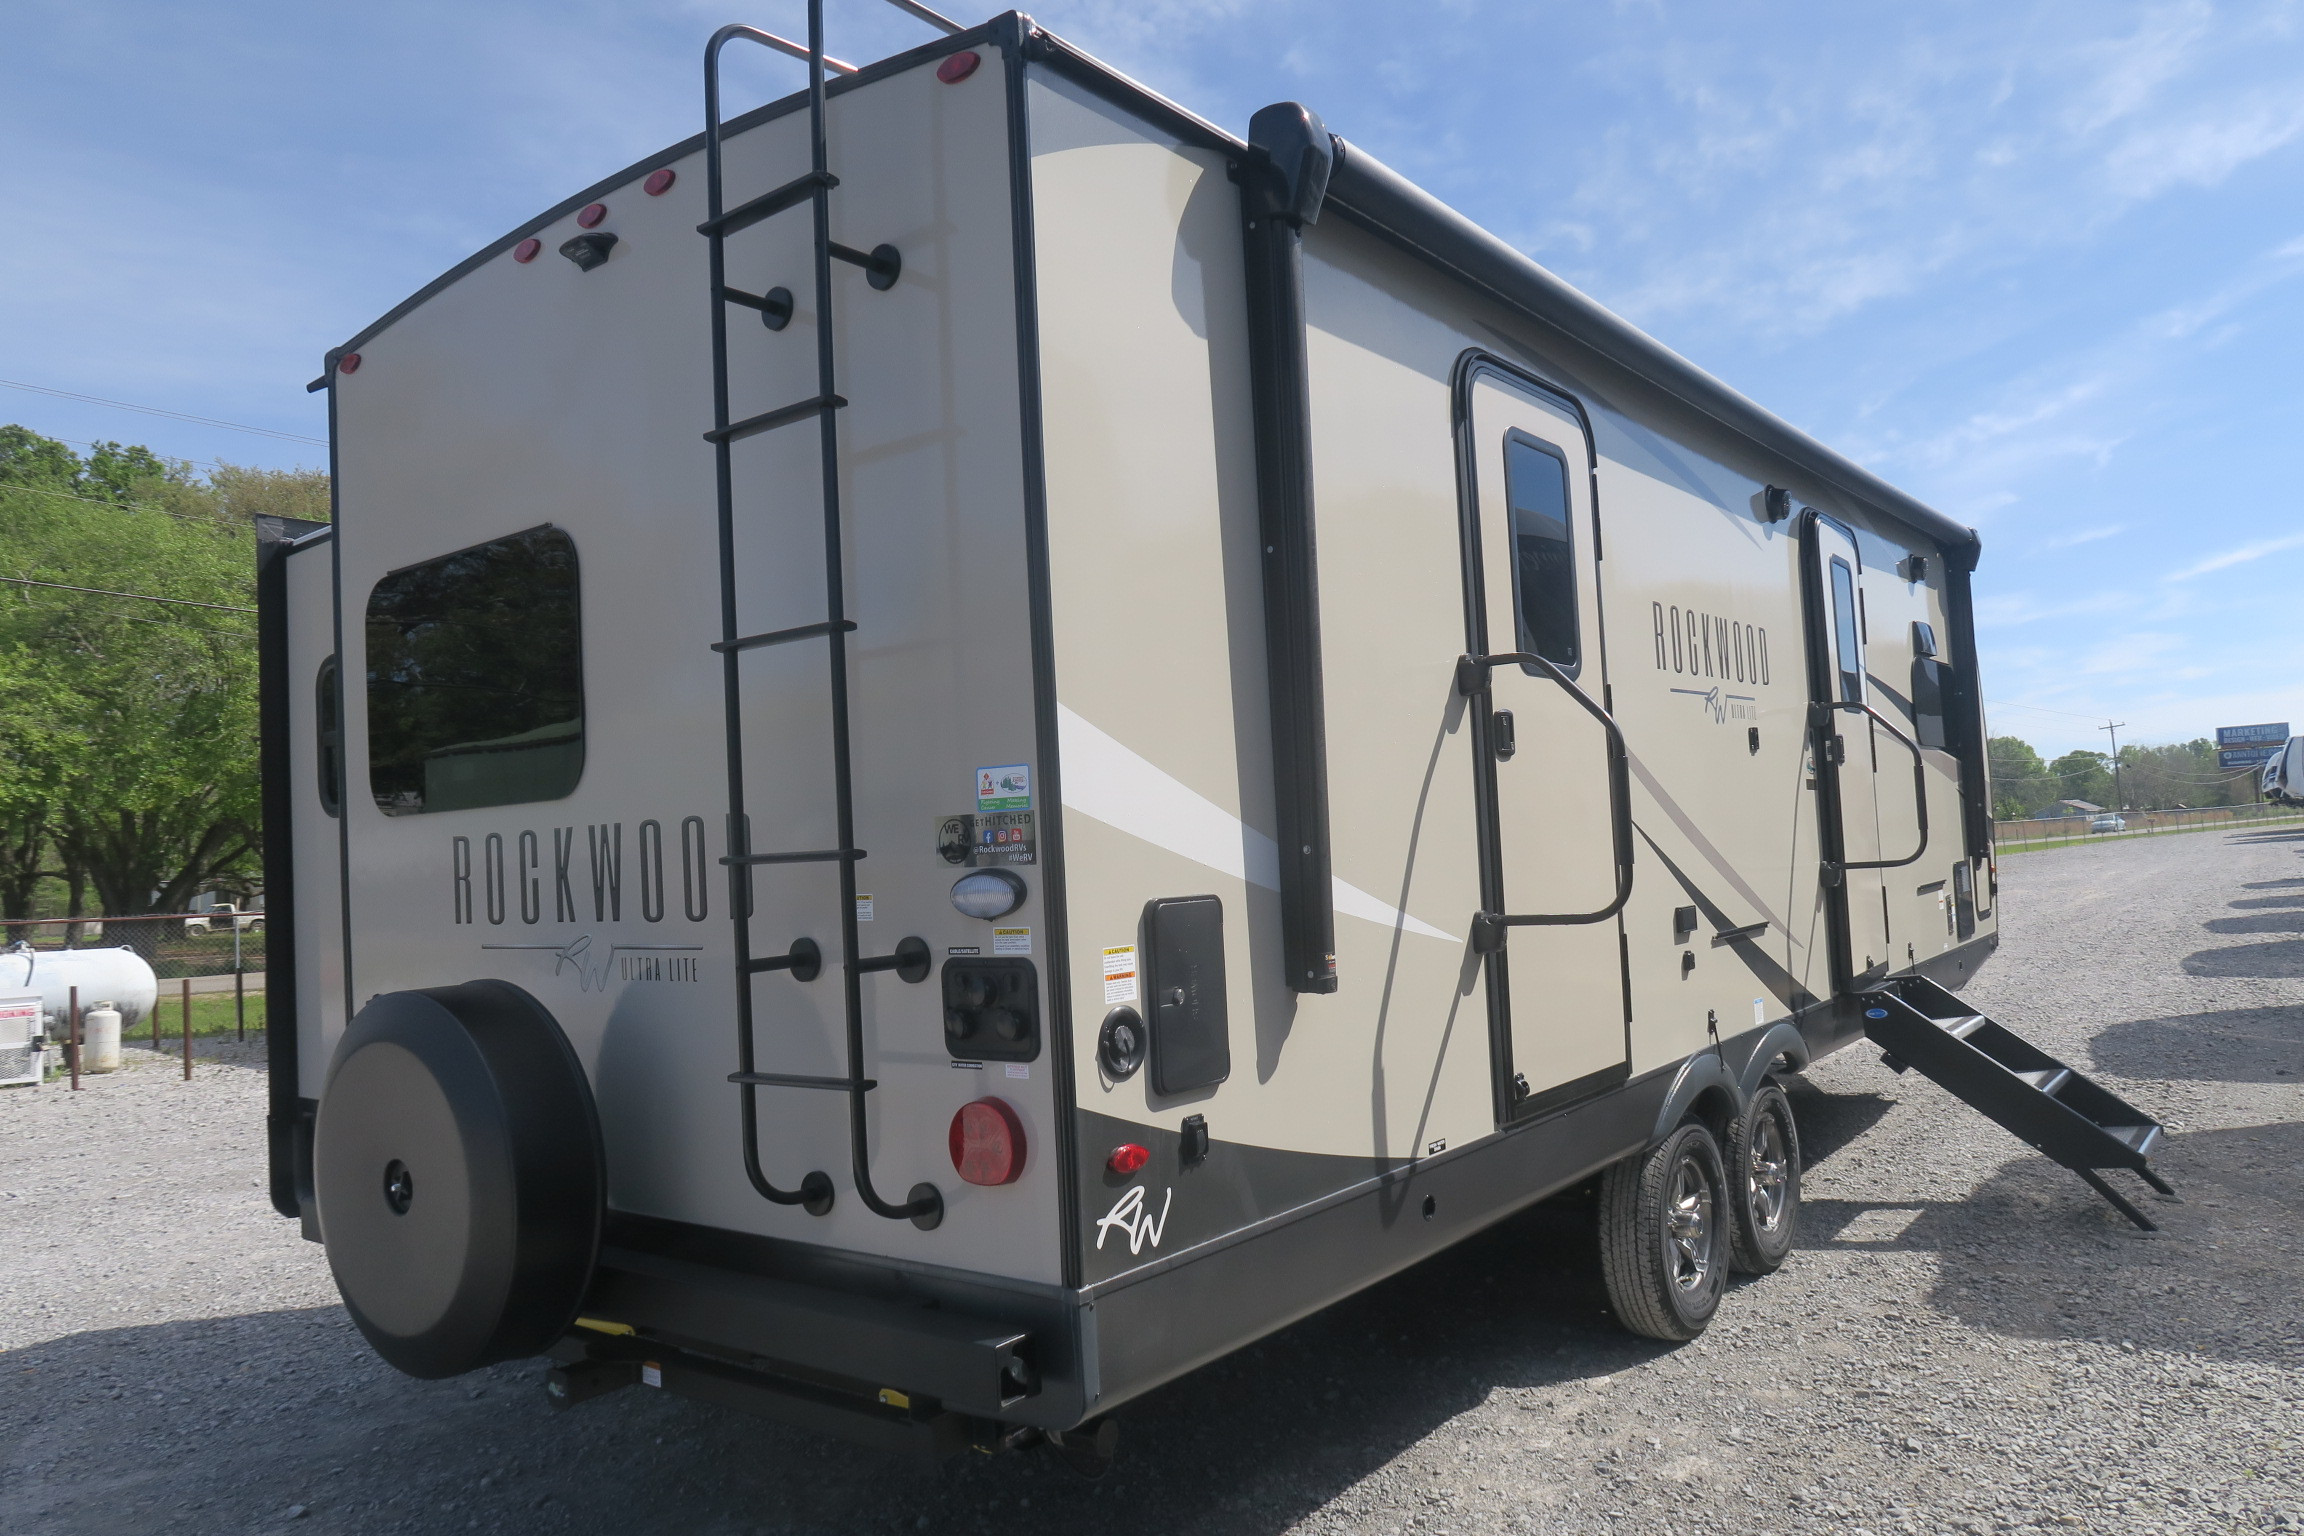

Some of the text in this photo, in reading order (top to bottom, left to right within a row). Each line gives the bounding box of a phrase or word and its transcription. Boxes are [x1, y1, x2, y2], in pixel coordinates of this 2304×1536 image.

[1652, 600, 1769, 685] ROCKWOOD
[2223, 725, 2278, 737] MARKETING
[944, 823, 959, 834] WE
[973, 844, 1027, 854] @RockwoodRVs
[1008, 853, 1033, 862] #WeRV
[621, 957, 698, 982] ULTRA LITE
[1097, 1185, 1172, 1255] RW
